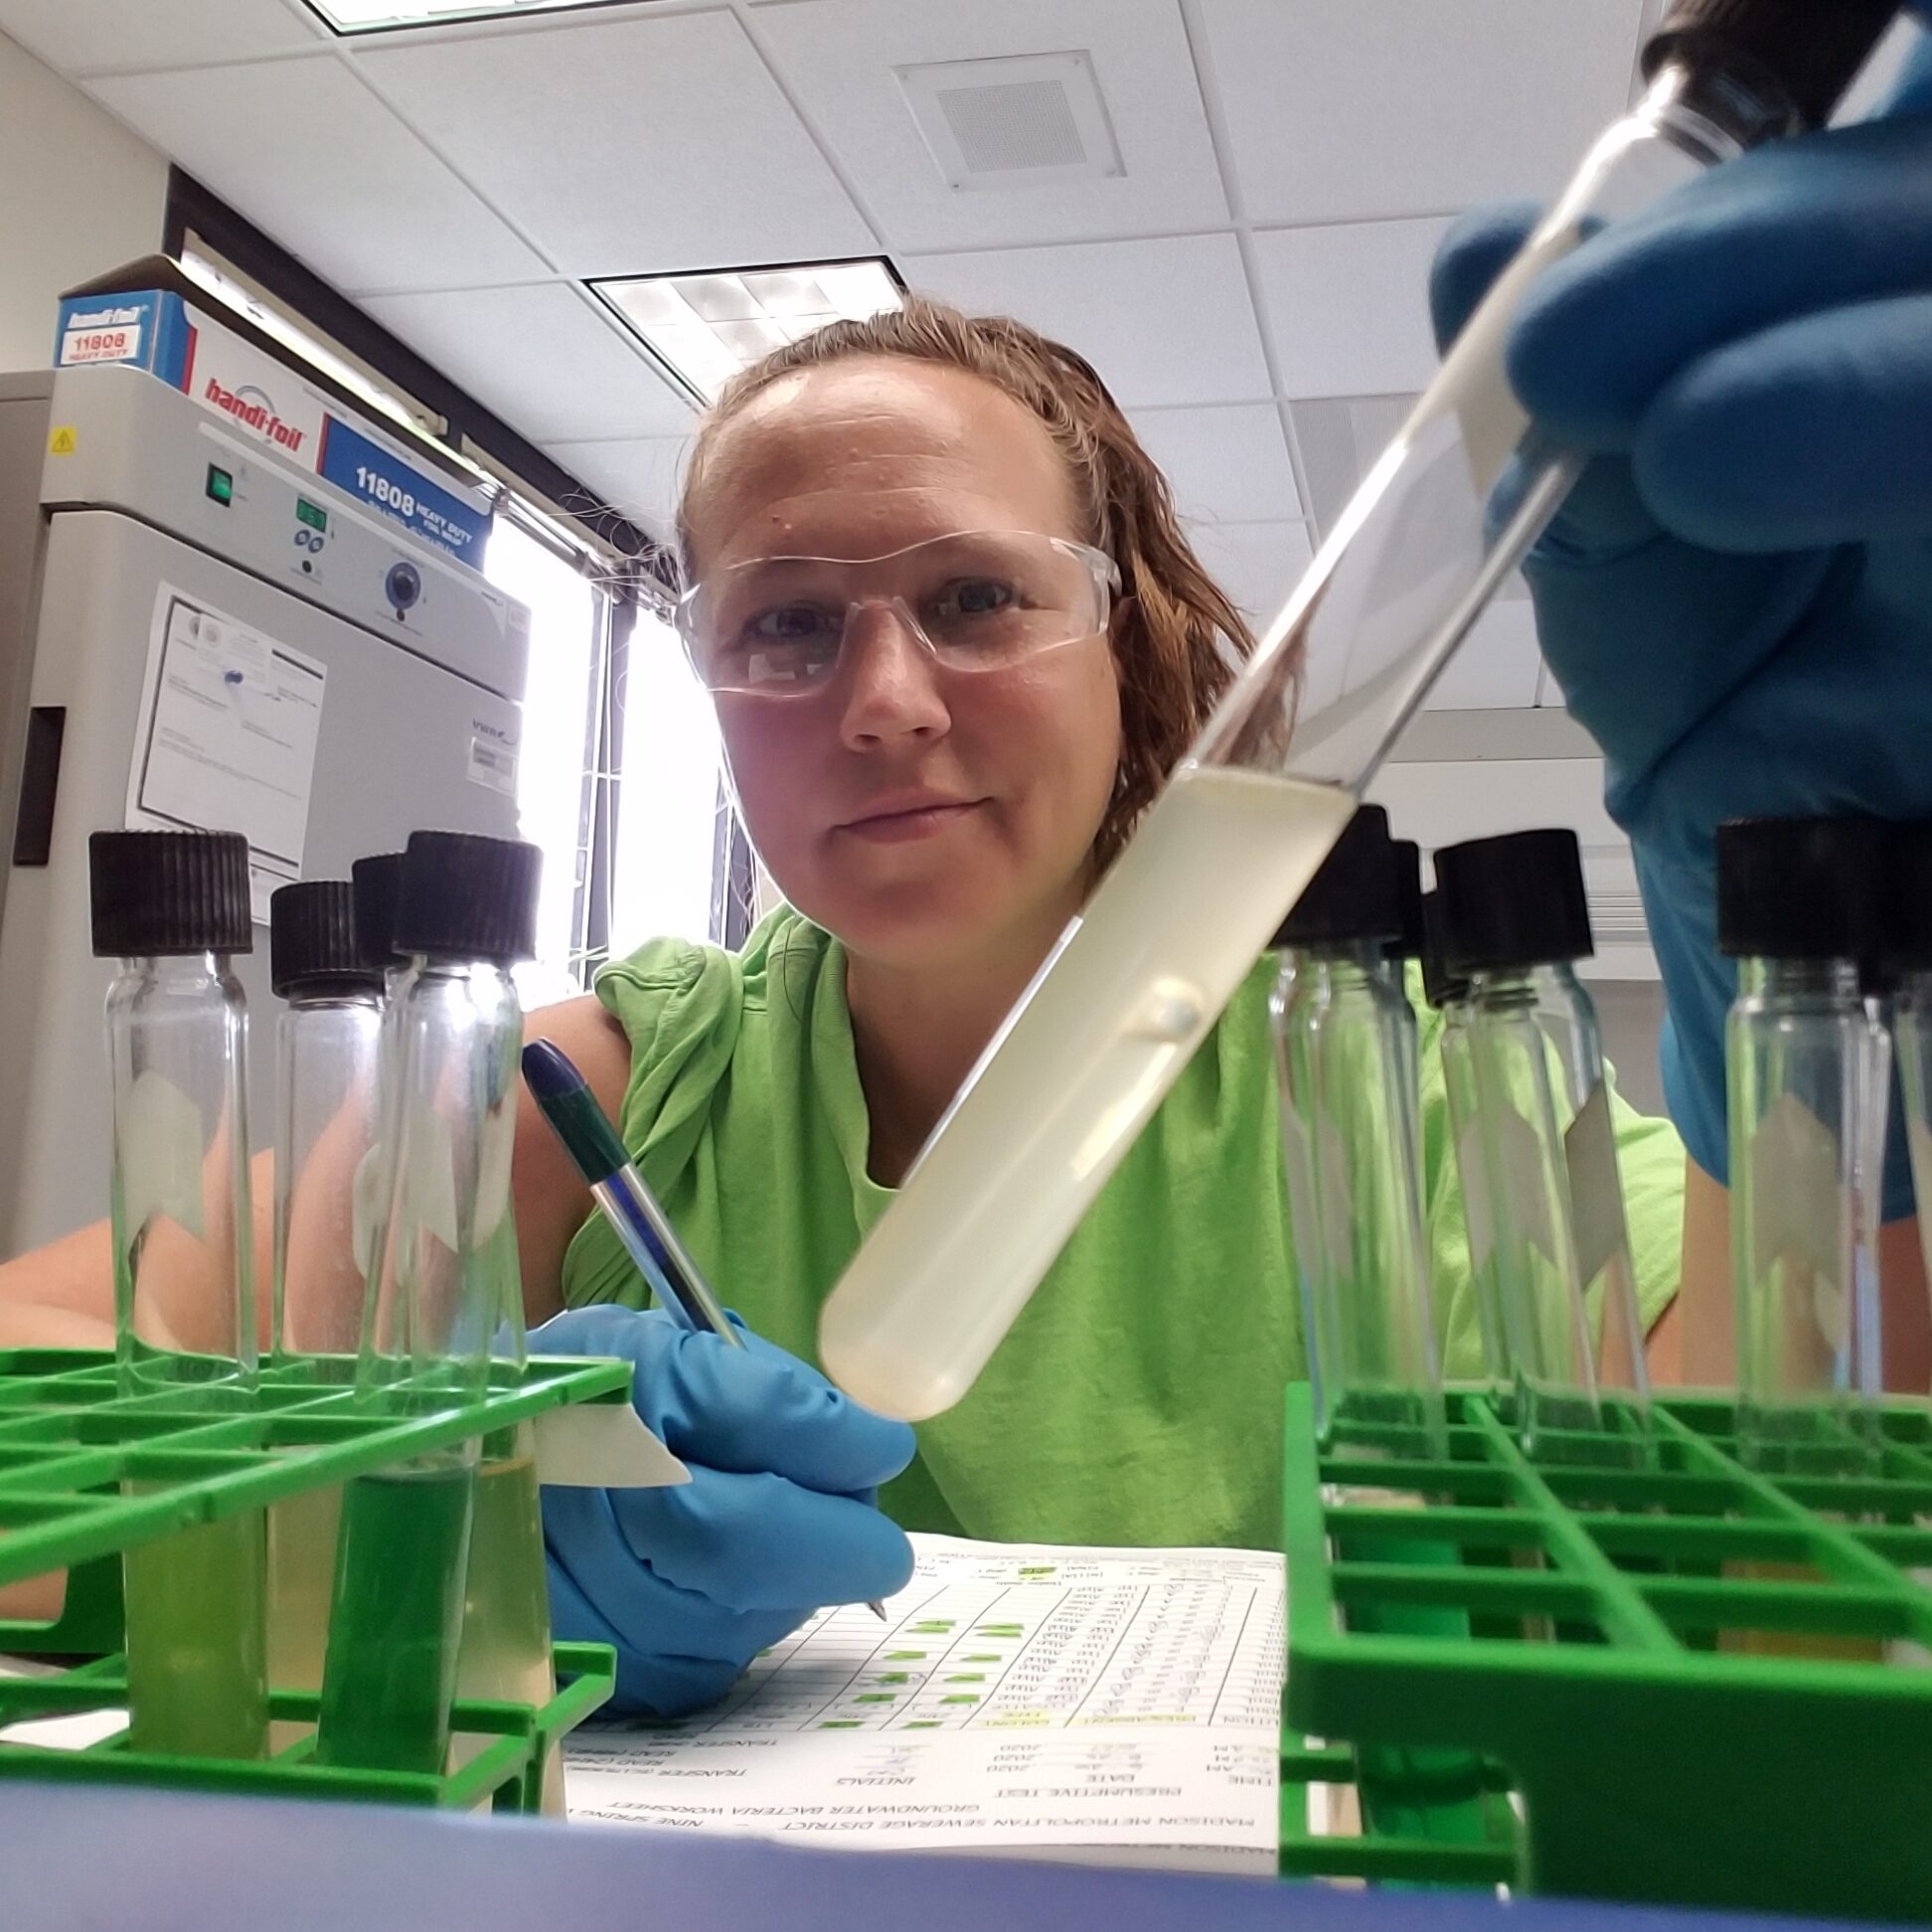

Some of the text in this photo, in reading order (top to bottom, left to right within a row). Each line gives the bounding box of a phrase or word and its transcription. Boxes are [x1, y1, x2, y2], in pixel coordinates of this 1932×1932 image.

[74, 333, 126, 352] 11808
[356, 466, 414, 517] 11808
[416, 502, 447, 528] HEAVY
[447, 523, 473, 544] DUTY
[657, 1768, 747, 1777] TRANSFER
[1085, 1773, 1135, 1784] DATE
[835, 1776, 915, 1786] INITIALS
[1227, 1775, 1272, 1786] TIME
[992, 1787, 1182, 1799] PRESUMPTIVE TEST
[605, 1801, 980, 1816] GROUNDWATER BACTERIA WORKSHEET
[579, 1809, 1255, 1831] MADISON METROPOLITAN SEWERAGE DISTRICT NINE SPRING
